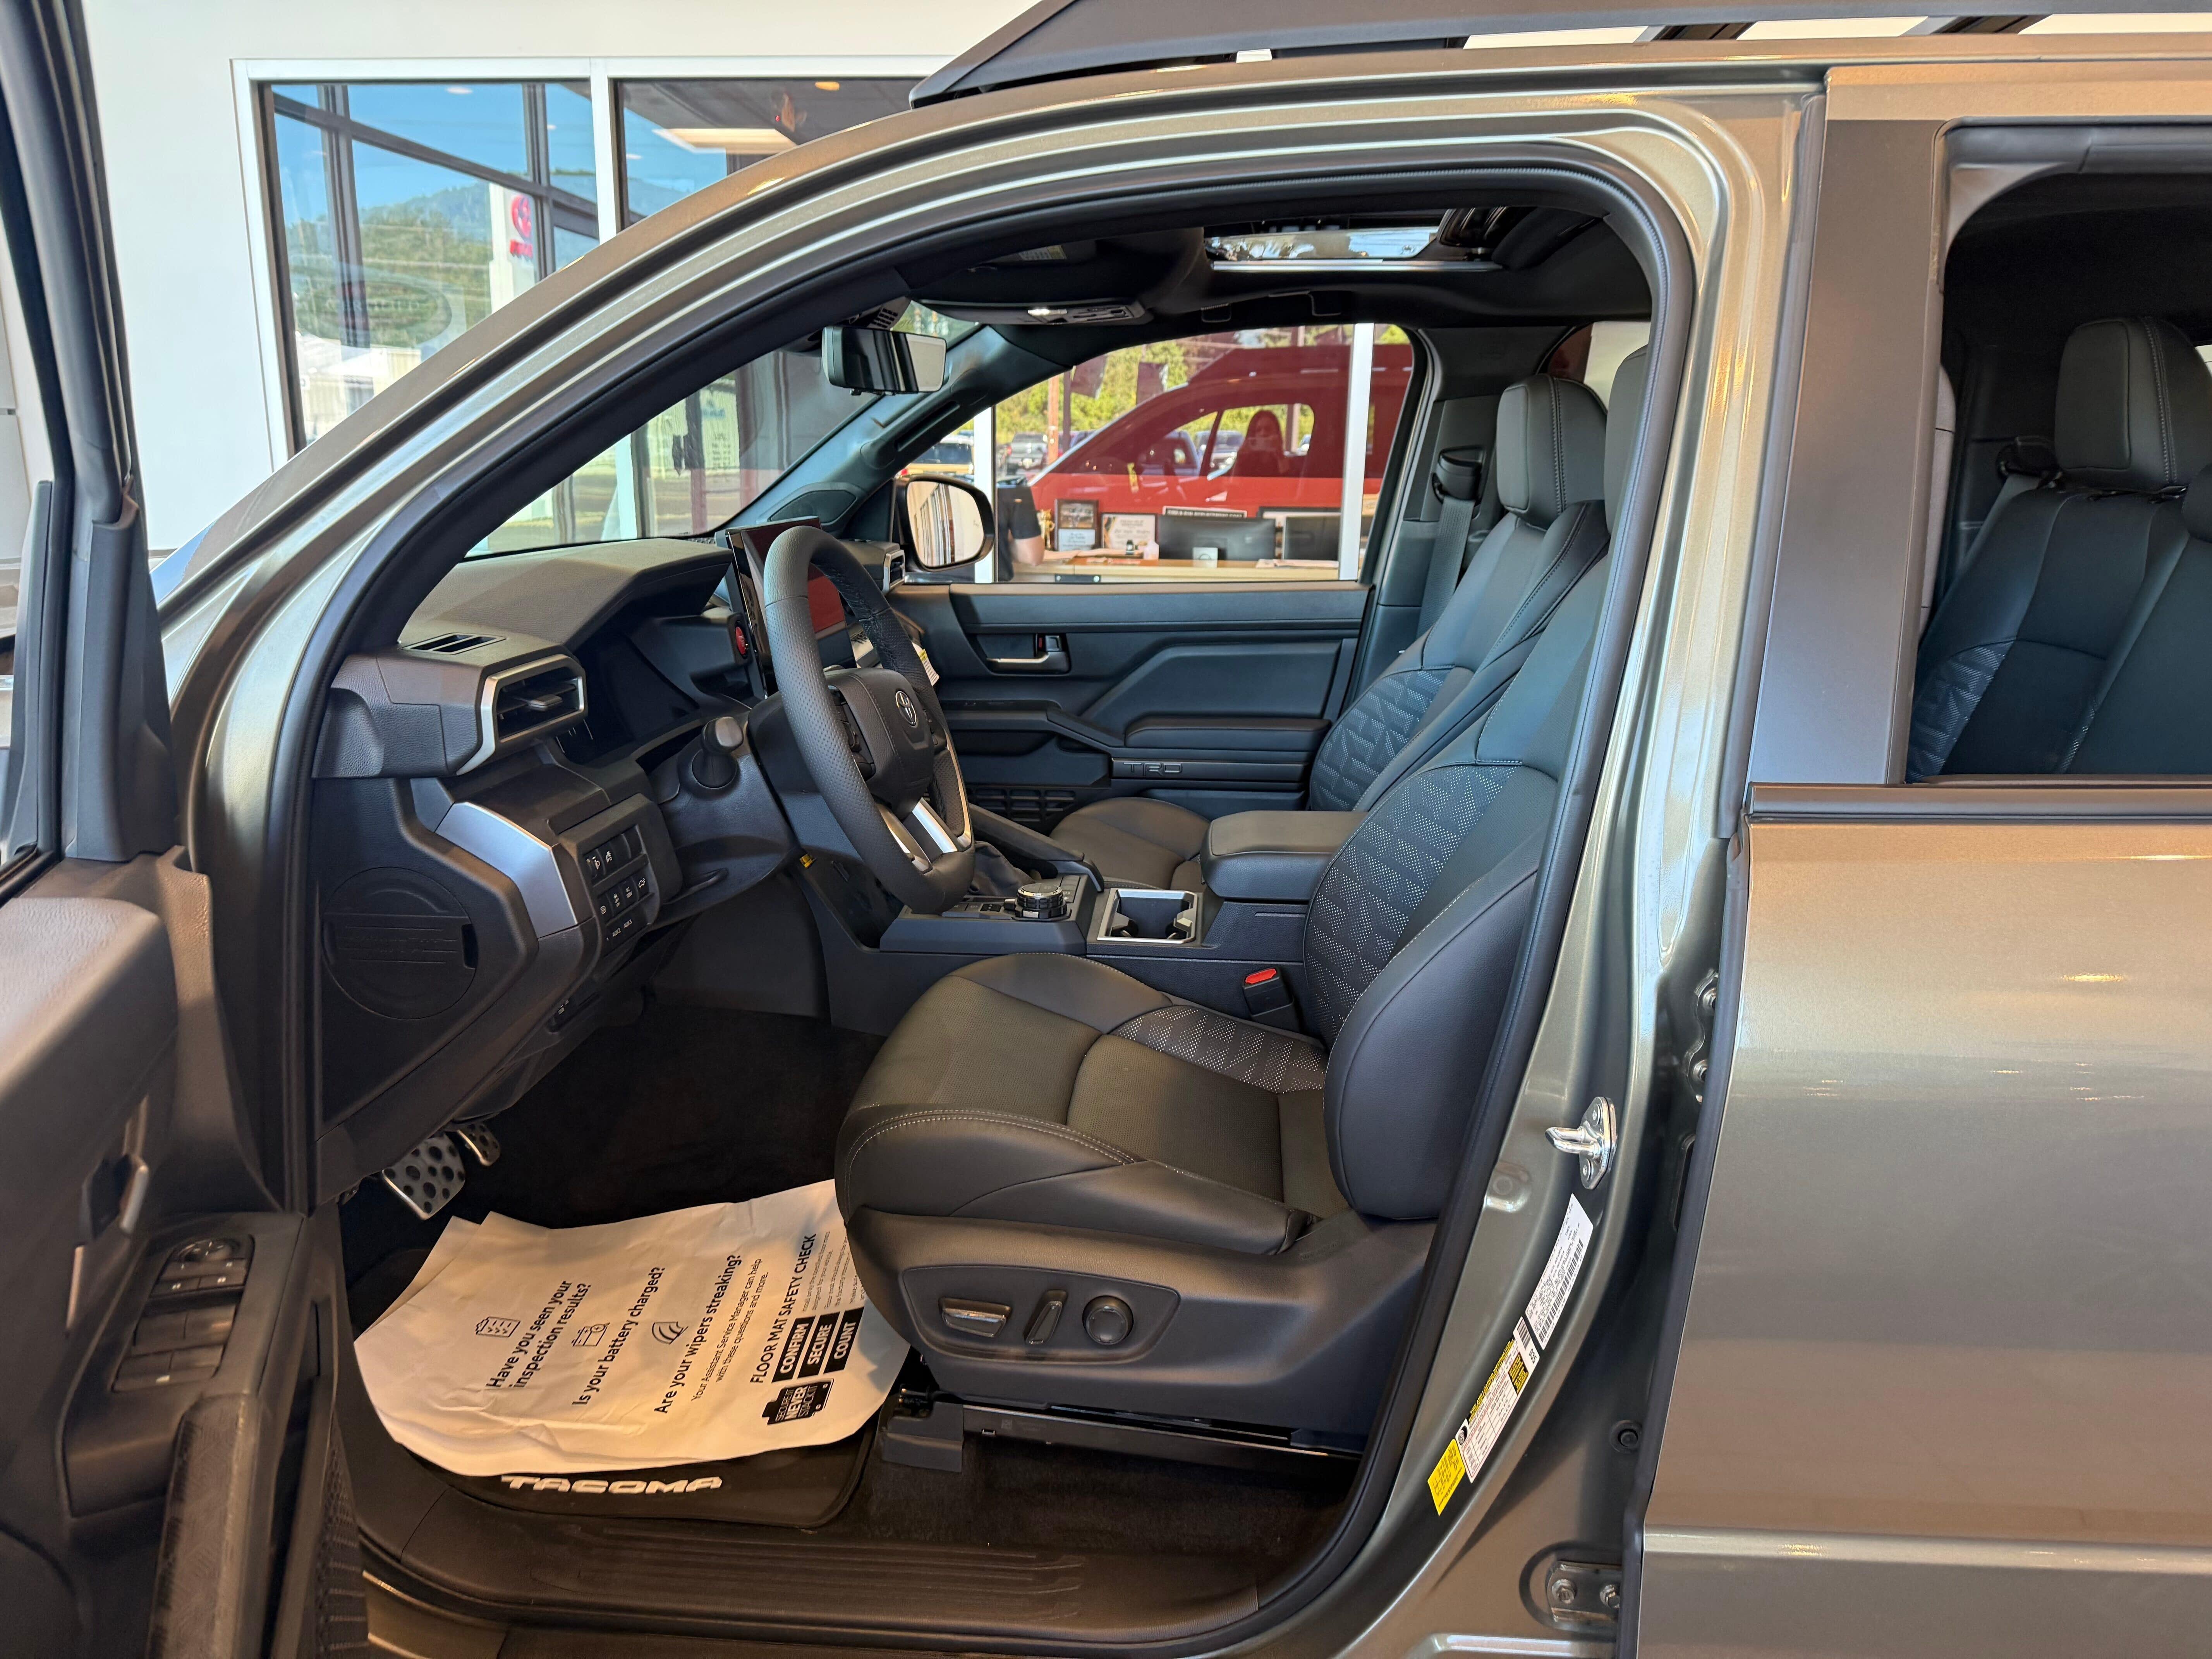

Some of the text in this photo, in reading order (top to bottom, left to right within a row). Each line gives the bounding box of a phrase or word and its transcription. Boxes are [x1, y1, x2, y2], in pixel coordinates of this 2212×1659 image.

[1123, 762, 1183, 776] TRD
[486, 1280, 572, 1388] Have you seen your
[509, 1283, 591, 1388] inspection results?
[572, 1267, 665, 1406] Is your battery charged?
[654, 1254, 742, 1413] Are your wipers streaking?
[691, 1259, 763, 1401] Your Assistant Service Manager can help
[716, 1272, 768, 1382] with these questions and more.
[750, 1233, 816, 1384] FLOOR MAT SAFETY CHECK
[807, 1324, 833, 1365] SECURE
[834, 1322, 857, 1359] COUNT
[780, 1323, 810, 1373] CONFIRM
[784, 1386, 808, 1420] NEVER
[798, 1391, 815, 1418] STACK
[501, 1475, 722, 1494] TACOMA
